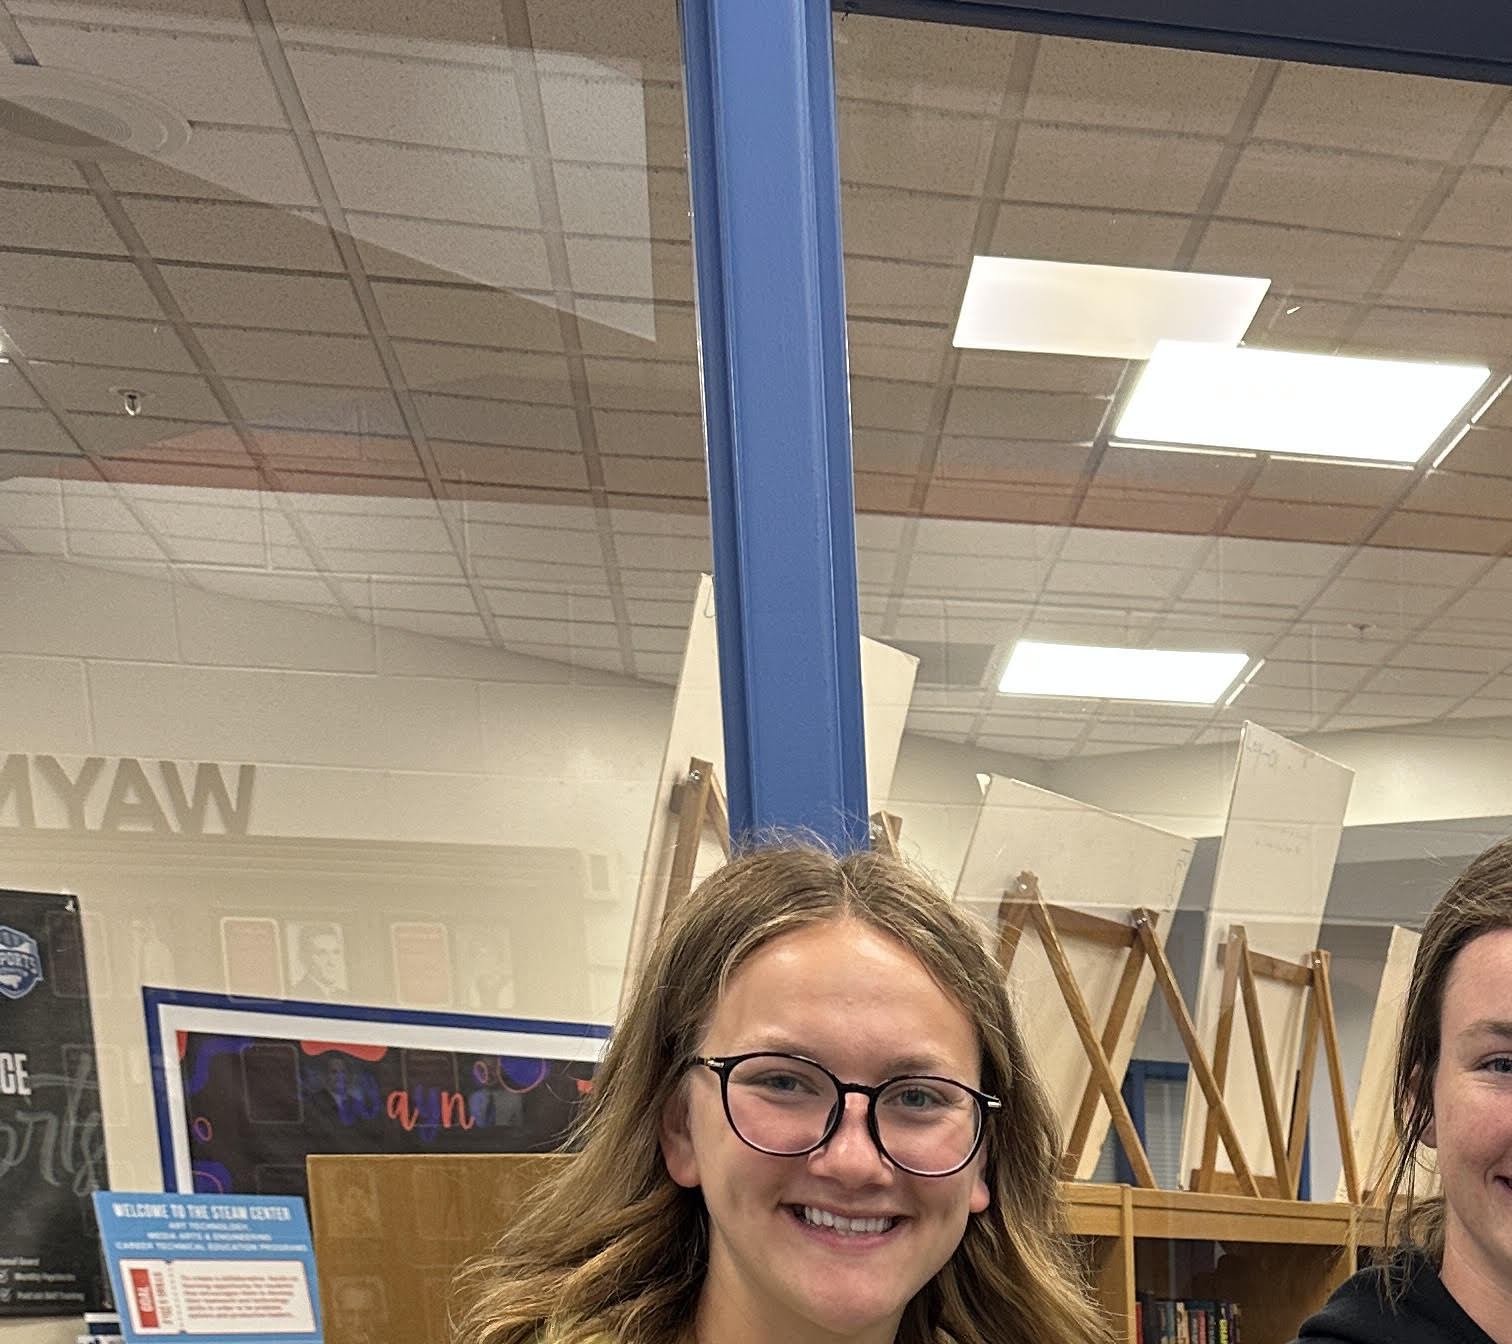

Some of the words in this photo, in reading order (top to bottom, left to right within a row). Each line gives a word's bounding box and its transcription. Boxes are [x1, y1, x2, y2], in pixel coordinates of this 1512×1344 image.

[112, 1203, 169, 1219] WELCOME
[170, 1204, 187, 1219] TO
[187, 1204, 210, 1219] THE
[210, 1205, 248, 1220] STEAM
[249, 1206, 292, 1221] CENTER
